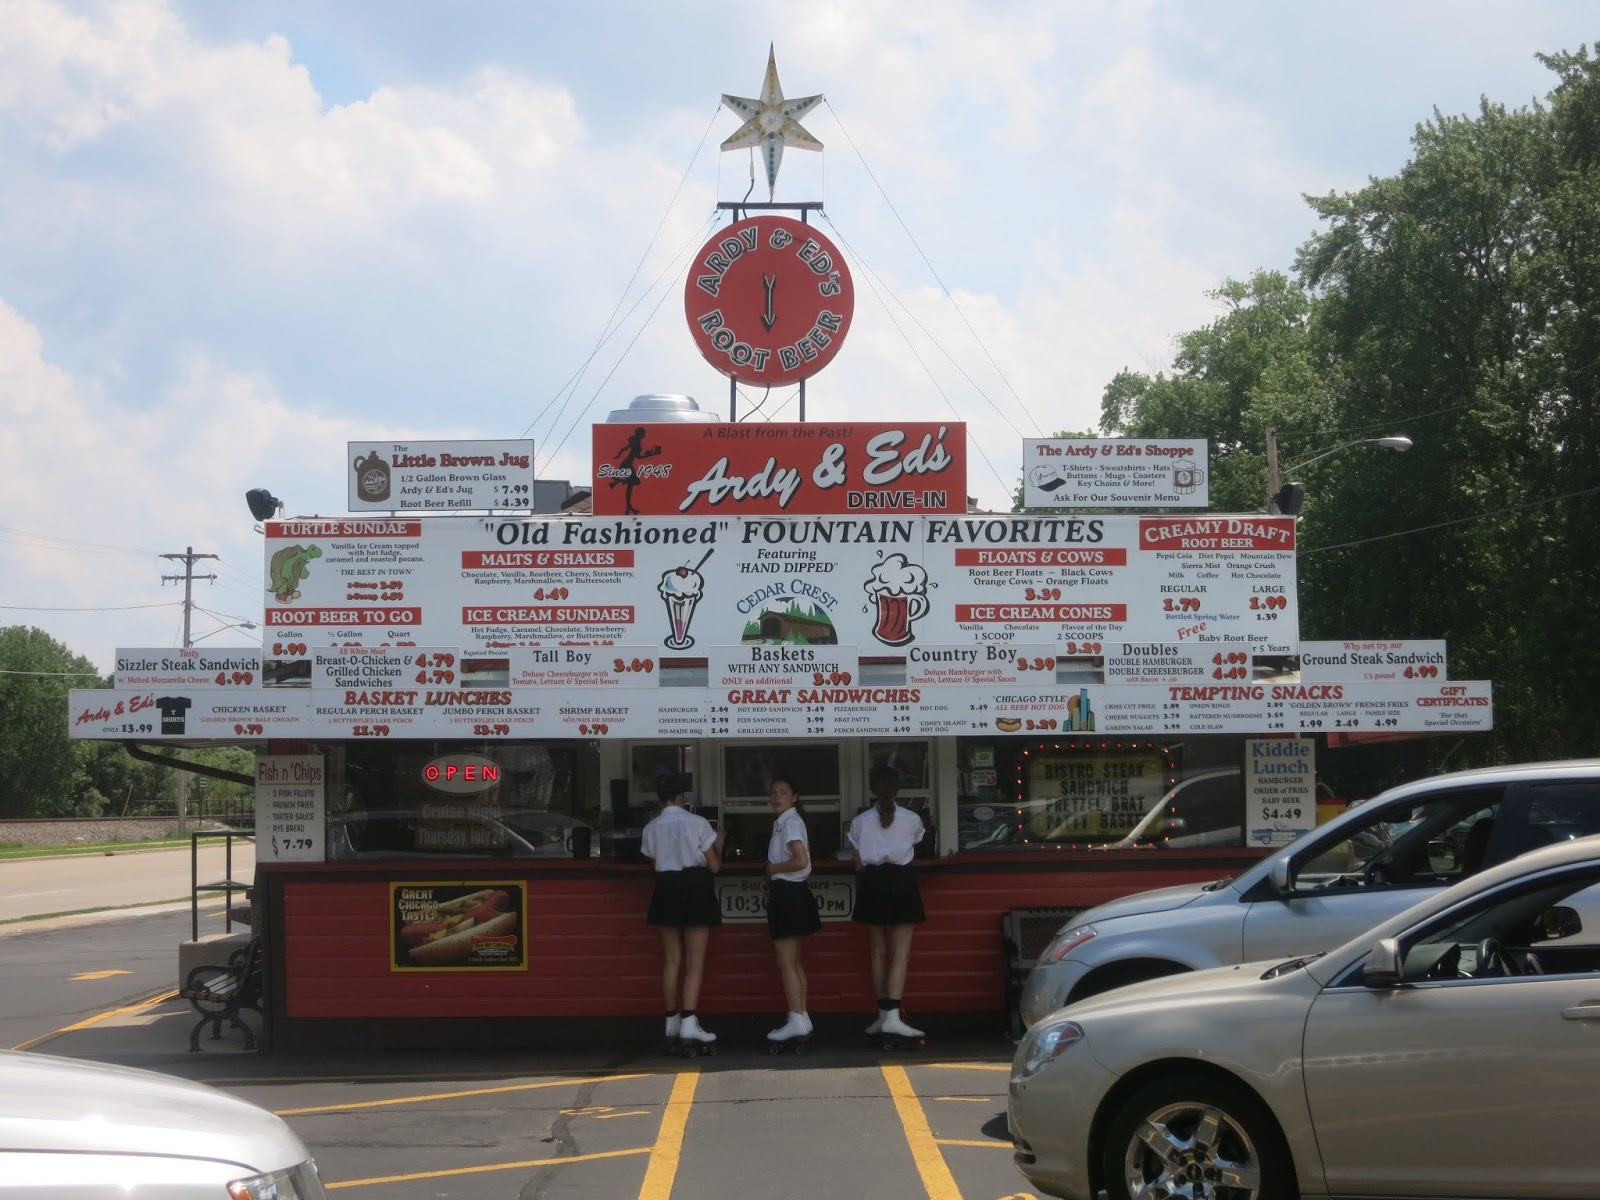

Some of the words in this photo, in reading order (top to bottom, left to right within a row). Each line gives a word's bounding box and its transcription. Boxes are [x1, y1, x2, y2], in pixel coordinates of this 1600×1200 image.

[697, 226, 758, 297] ARDY
[770, 228, 792, 248] &
[698, 309, 770, 372] ROOT
[778, 310, 842, 372] BEER
[1037, 445, 1062, 456] The
[1065, 445, 1097, 458] Ardy
[1102, 445, 1113, 456] &
[1116, 445, 1141, 456] Ed's
[1146, 445, 1194, 458] Shoppe
[393, 454, 436, 468] Little
[440, 454, 495, 467] Brown
[499, 453, 529, 468] Jug
[597, 465, 631, 478] Since
[636, 465, 671, 478] 1948
[679, 457, 801, 511] Ardy
[812, 443, 847, 488] &
[863, 426, 951, 485] Ed's
[400, 486, 422, 495] Ardy
[456, 486, 473, 494] Jug
[502, 485, 528, 493] 7.99
[847, 491, 946, 508] DRIVE-IN
[280, 523, 339, 535] TURTLE
[343, 522, 407, 534] SUNDAE
[484, 522, 550, 545] "Old
[562, 521, 728, 545] Fashioned"
[741, 520, 915, 544] FOUNTAIN
[926, 519, 1104, 543] FAVORITES
[1145, 520, 1223, 542] CREAMY
[1228, 520, 1290, 543] DRAFT
[1182, 538, 1217, 548] ROOT
[1221, 538, 1253, 548] BEER
[481, 553, 532, 566] MALTS
[537, 553, 550, 565] &
[553, 553, 614, 565] SHAKES
[757, 549, 816, 560] Featuring
[978, 552, 1036, 563] FLOATS
[1041, 552, 1053, 563] &
[1057, 552, 1104, 562] COWS
[737, 564, 780, 573] "HAND
[784, 563, 838, 572] DIPPED"
[533, 587, 569, 600] 4.49
[737, 582, 785, 614] CEDAR
[1025, 588, 1061, 601] 3.39
[1163, 598, 1200, 612] 1.79
[1249, 596, 1287, 610] 1.99
[272, 611, 315, 623] ROOT
[319, 611, 360, 623] BEER
[363, 611, 385, 622] TO
[390, 611, 413, 622] GO
[467, 609, 492, 622] ICE
[496, 609, 552, 621] CREAM
[556, 608, 629, 621] SUNDAES
[970, 608, 995, 619] ICE
[1000, 607, 1054, 619] CREAM
[1059, 607, 1112, 618] CONES
[180, 650, 199, 658] Tasty
[272, 643, 307, 656] 5.99
[751, 647, 815, 661] Baskets
[1066, 642, 1102, 654] 3.29
[1123, 644, 1178, 656] Doubles
[118, 659, 158, 671] Sizzler
[162, 659, 196, 670] Steak
[200, 658, 259, 670] Sandwich
[316, 656, 400, 666] Breast-O-Chicken
[404, 656, 412, 665] &
[415, 653, 455, 668] 4.79
[533, 650, 558, 663] Tall
[566, 650, 592, 665] Boy
[613, 658, 654, 673] 3.69
[910, 648, 977, 663] Country
[987, 646, 1017, 663] Boy
[1016, 658, 1056, 671] 3.39
[1212, 652, 1247, 665] 4.09
[1303, 654, 1347, 665] Ground
[1351, 653, 1384, 664] Steak
[1387, 653, 1443, 664] Sandwich
[326, 667, 360, 677] Grilled
[363, 666, 401, 676] Chicken
[415, 670, 455, 684] 4.79
[1212, 667, 1247, 680] 4.49
[1403, 666, 1438, 678] 4.99
[335, 678, 392, 688] Sandwiches
[728, 690, 791, 704] GREAT
[796, 688, 920, 704] SANDWICHES
[1169, 687, 1265, 700] TEMPTING
[1272, 686, 1343, 700] SNACKS
[1440, 687, 1467, 696] GIFT
[344, 691, 418, 705] BASKET
[424, 691, 512, 706] LUNCHES
[1416, 697, 1488, 706] CERTIFICATES
[74, 708, 110, 726] Ardy
[114, 701, 124, 715] &
[129, 693, 155, 712] Ed's
[121, 724, 152, 732] 13.99
[234, 724, 263, 735] 9.79
[1252, 743, 1309, 757] Kiddie
[259, 761, 278, 781] Fish
[282, 769, 288, 780] n
[426, 766, 497, 781] OPEN
[1045, 765, 1093, 778] BISTRO
[1103, 764, 1144, 778] STEAK
[1254, 760, 1308, 774] Lunch
[1061, 781, 1128, 795] SANDWICH
[1112, 797, 1144, 811] BRAT
[1263, 807, 1301, 820] $4.49
[283, 839, 312, 849] 7.79
[402, 889, 433, 899] GREAT
[399, 899, 439, 910] CHICAGO
[401, 910, 434, 920] TASTE!
